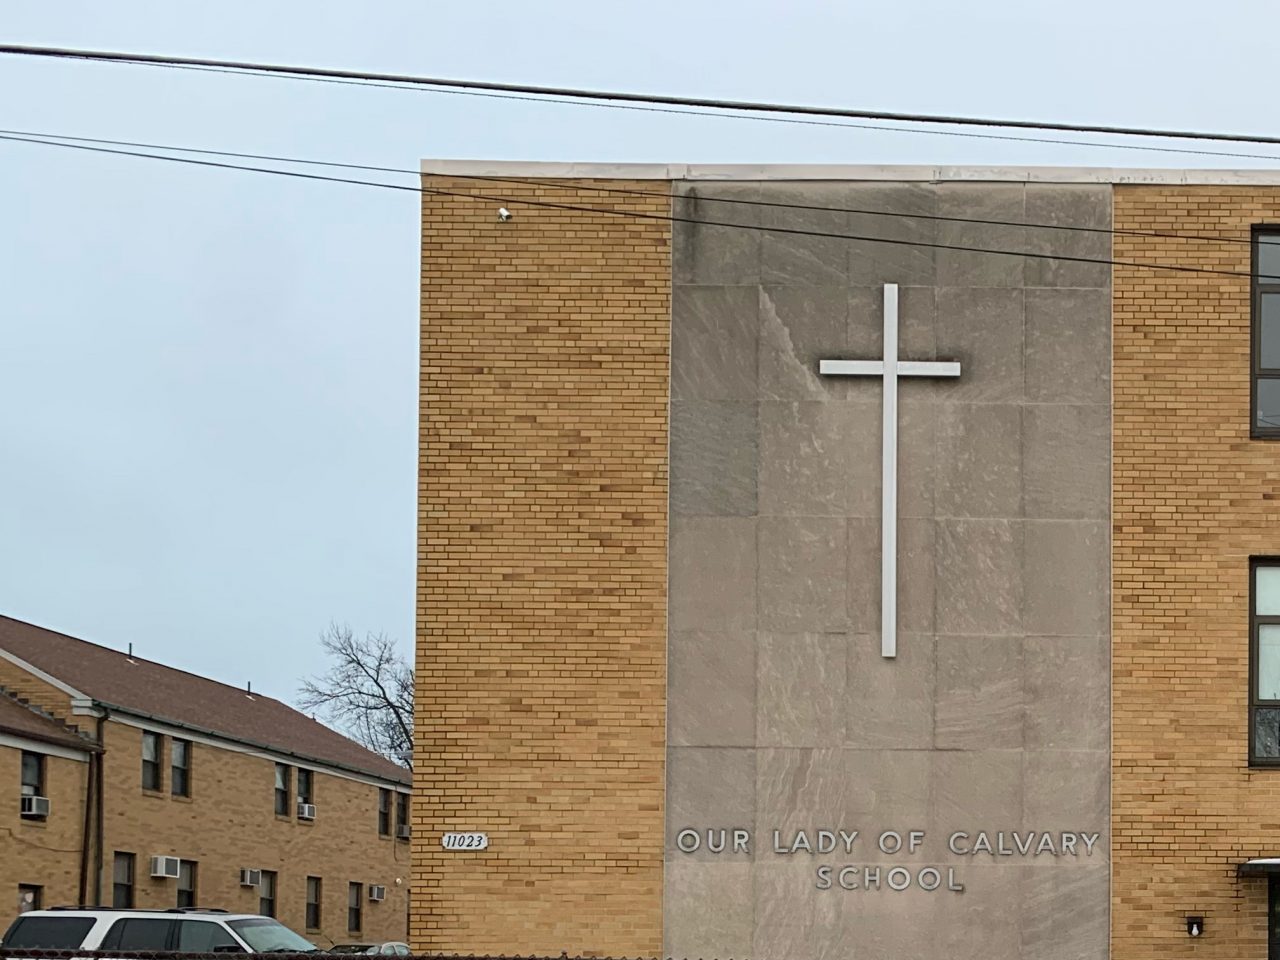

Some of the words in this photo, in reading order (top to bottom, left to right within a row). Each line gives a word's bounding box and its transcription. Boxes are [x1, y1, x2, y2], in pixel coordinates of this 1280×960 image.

[446, 835, 483, 848] 11023
[676, 829, 749, 853] OUR
[773, 830, 859, 854] LADY
[878, 831, 924, 854] OF
[949, 832, 1100, 856] CALVARY
[816, 865, 964, 891] SCHOOL
